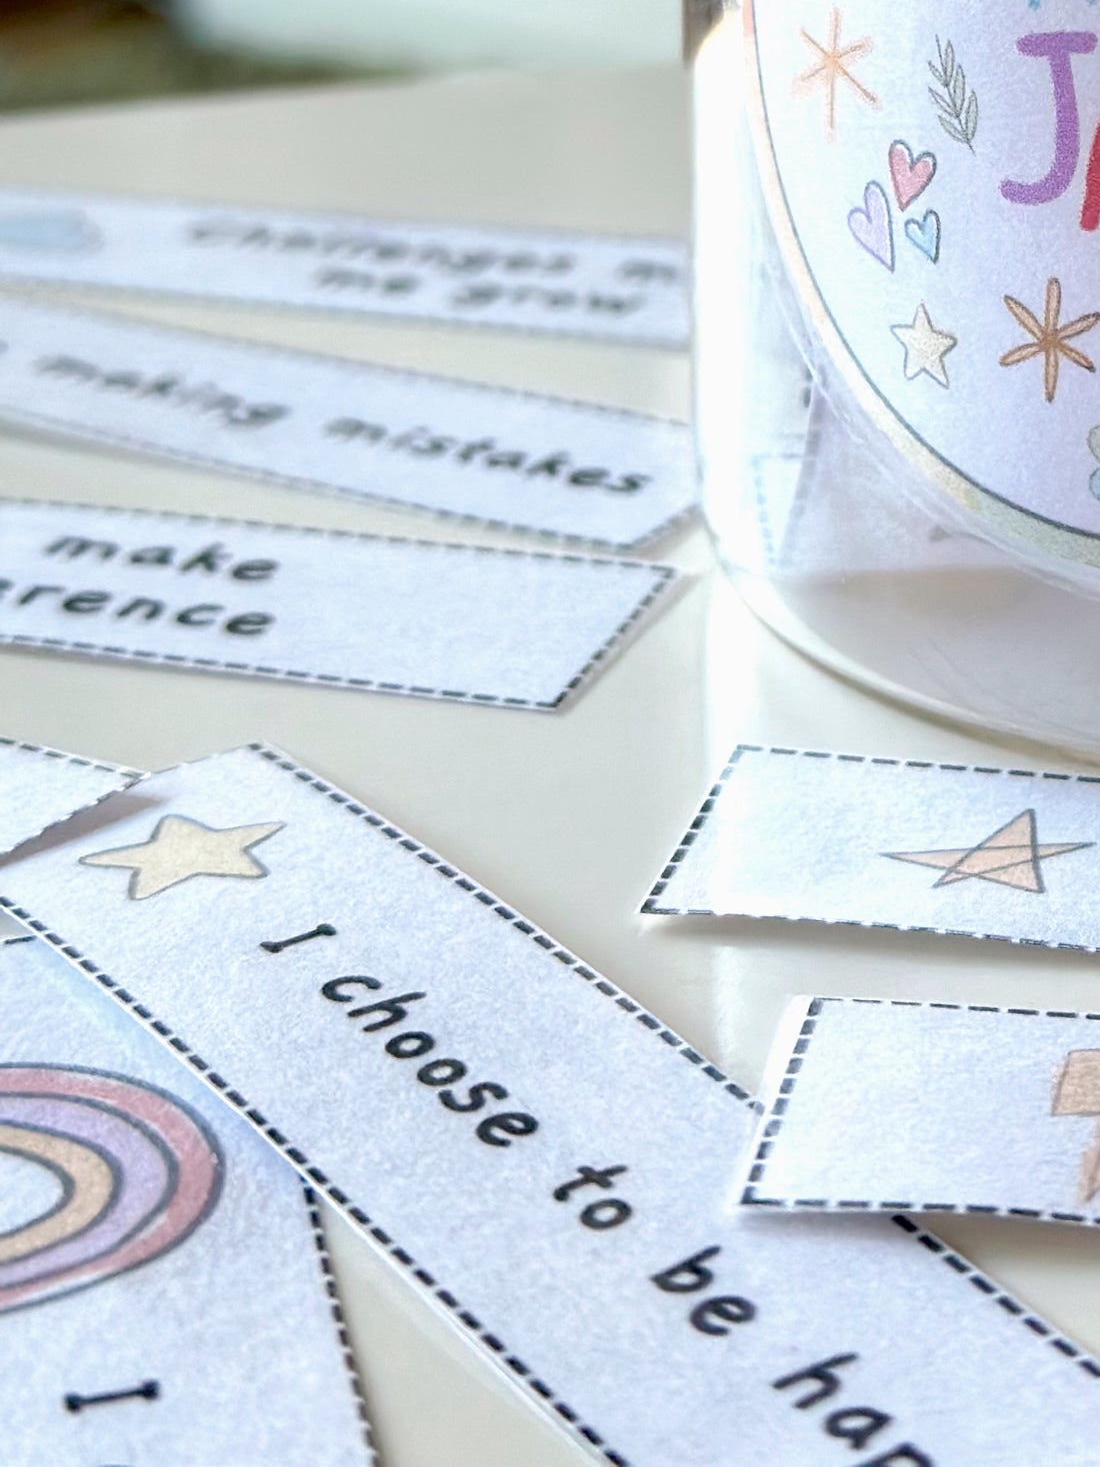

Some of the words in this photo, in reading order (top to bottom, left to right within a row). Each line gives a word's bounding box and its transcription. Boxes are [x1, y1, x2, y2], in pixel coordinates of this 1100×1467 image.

[33, 353, 292, 428] making
[323, 415, 653, 497] mistakes
[42, 533, 282, 587] make
[259, 922, 338, 954] I
[319, 974, 540, 1149] choose
[551, 1163, 635, 1232] to
[649, 1244, 758, 1338] be
